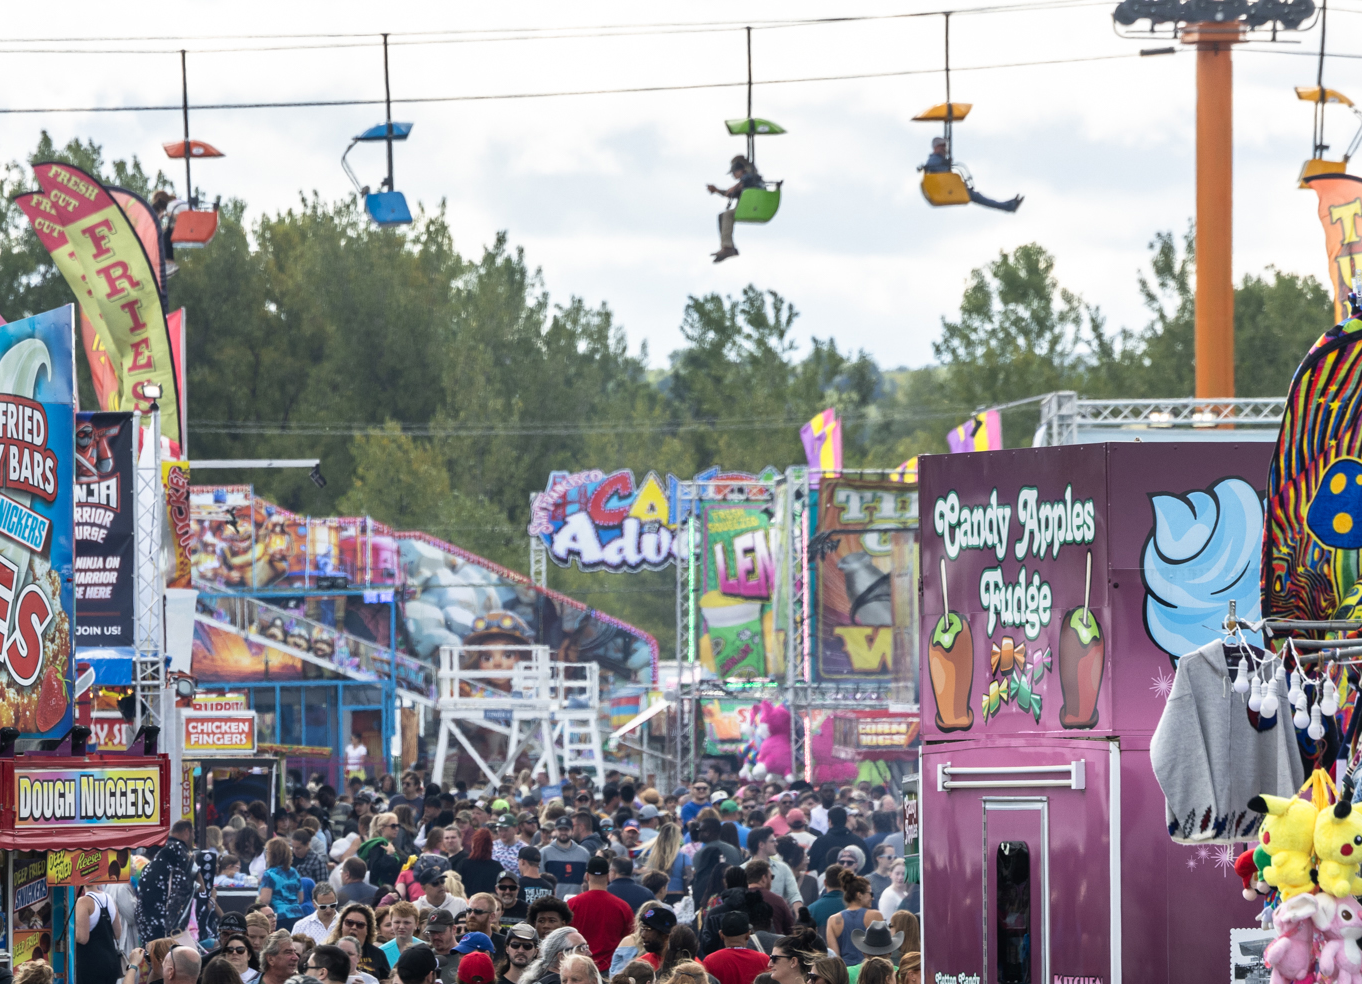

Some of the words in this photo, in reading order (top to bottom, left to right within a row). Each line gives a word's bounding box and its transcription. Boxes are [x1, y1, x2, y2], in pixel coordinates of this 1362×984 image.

[48, 165, 99, 202] FRESH
[49, 189, 79, 212] CUT
[34, 217, 64, 238] CUT
[81, 218, 155, 415] FRIES
[9, 446, 55, 496] BARS
[75, 476, 118, 508] NJA
[75, 508, 114, 527] RRIOR
[167, 467, 191, 560] UCKET
[935, 488, 1011, 560] Candy
[1015, 484, 1096, 560] Apples
[75, 526, 108, 543] URSE
[75, 557, 104, 569] NINJA
[105, 556, 121, 569] ON
[85, 586, 113, 599] HERE
[980, 566, 1052, 639] Fudge
[75, 626, 102, 636] JOIN
[104, 625, 121, 635] US!
[188, 721, 249, 734] CHICKEN
[190, 733, 247, 745] FINGERS
[18, 776, 76, 821] DOUGH
[80, 775, 155, 819] NUGGETS
[49, 850, 65, 871] DEEP
[14, 867, 28, 886] DEEP
[29, 860, 46, 879] FRIED
[55, 861, 73, 885] FRIED
[15, 877, 47, 910] SNICKERS
[26, 932, 40, 951] FRIED
